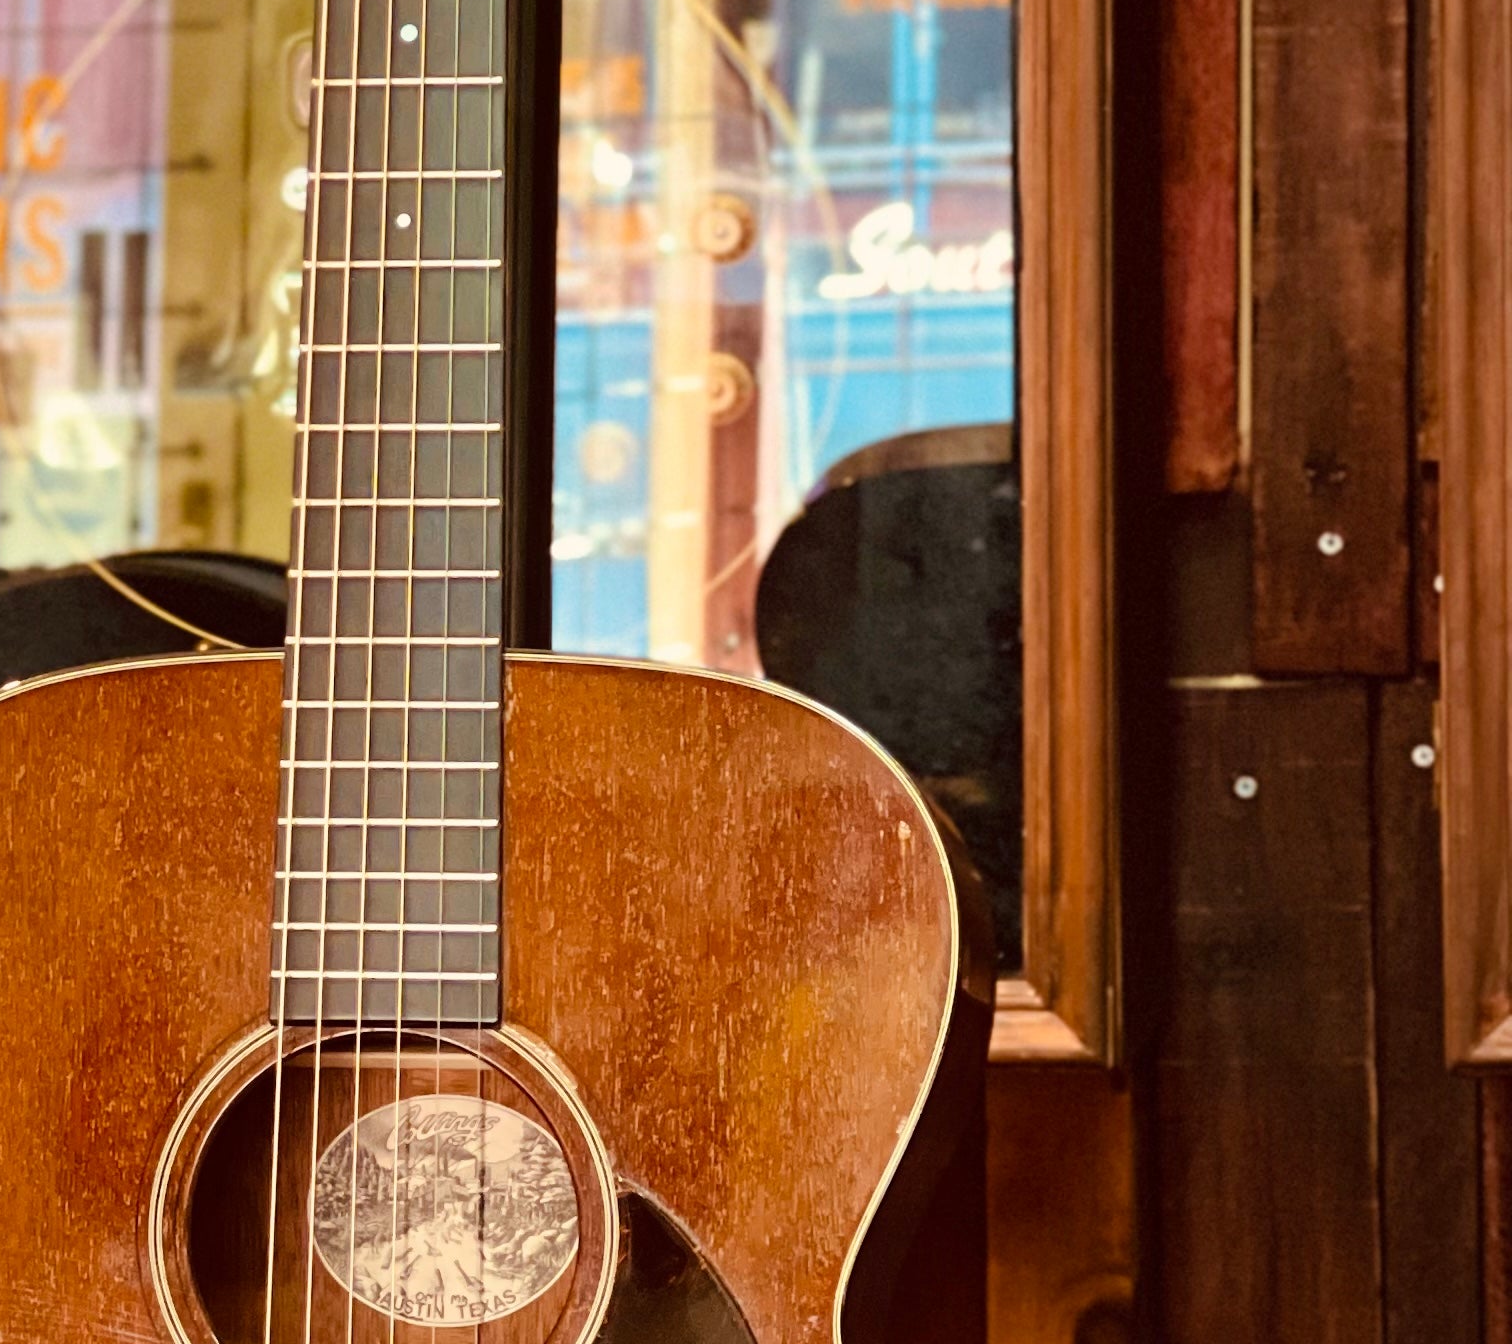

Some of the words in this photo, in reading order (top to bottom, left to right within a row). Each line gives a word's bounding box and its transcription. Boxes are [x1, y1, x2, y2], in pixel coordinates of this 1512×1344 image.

[386, 1104, 501, 1151] Collings
[378, 1291, 446, 1320] AUSTIN
[457, 1288, 518, 1319] TEXAS
